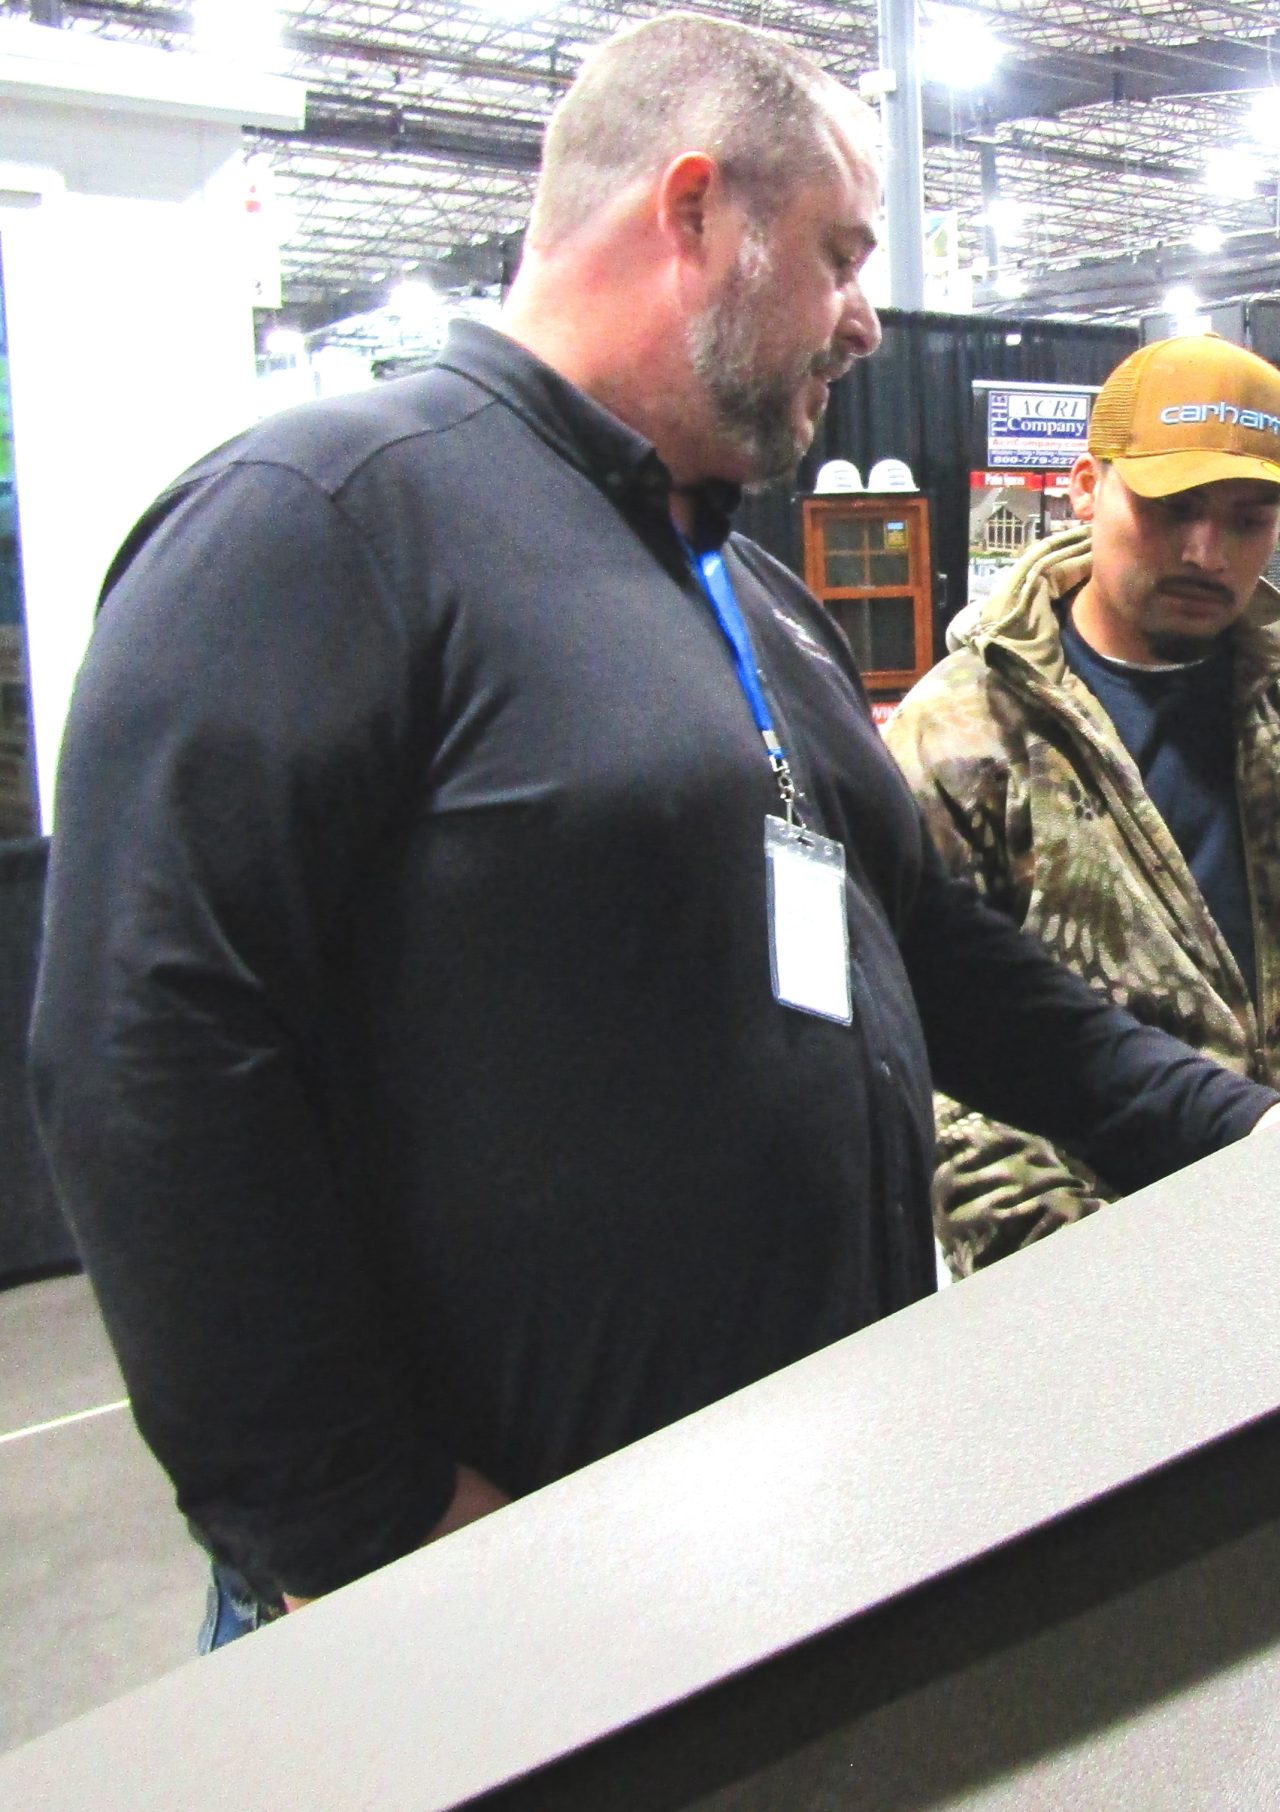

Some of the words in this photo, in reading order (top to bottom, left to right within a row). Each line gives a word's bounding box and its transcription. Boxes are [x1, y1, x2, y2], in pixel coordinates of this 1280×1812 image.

[990, 394, 1008, 437] THE
[1019, 398, 1079, 418] ACRI
[1007, 416, 1085, 436] Company
[993, 456, 1076, 465] 800-779-227
